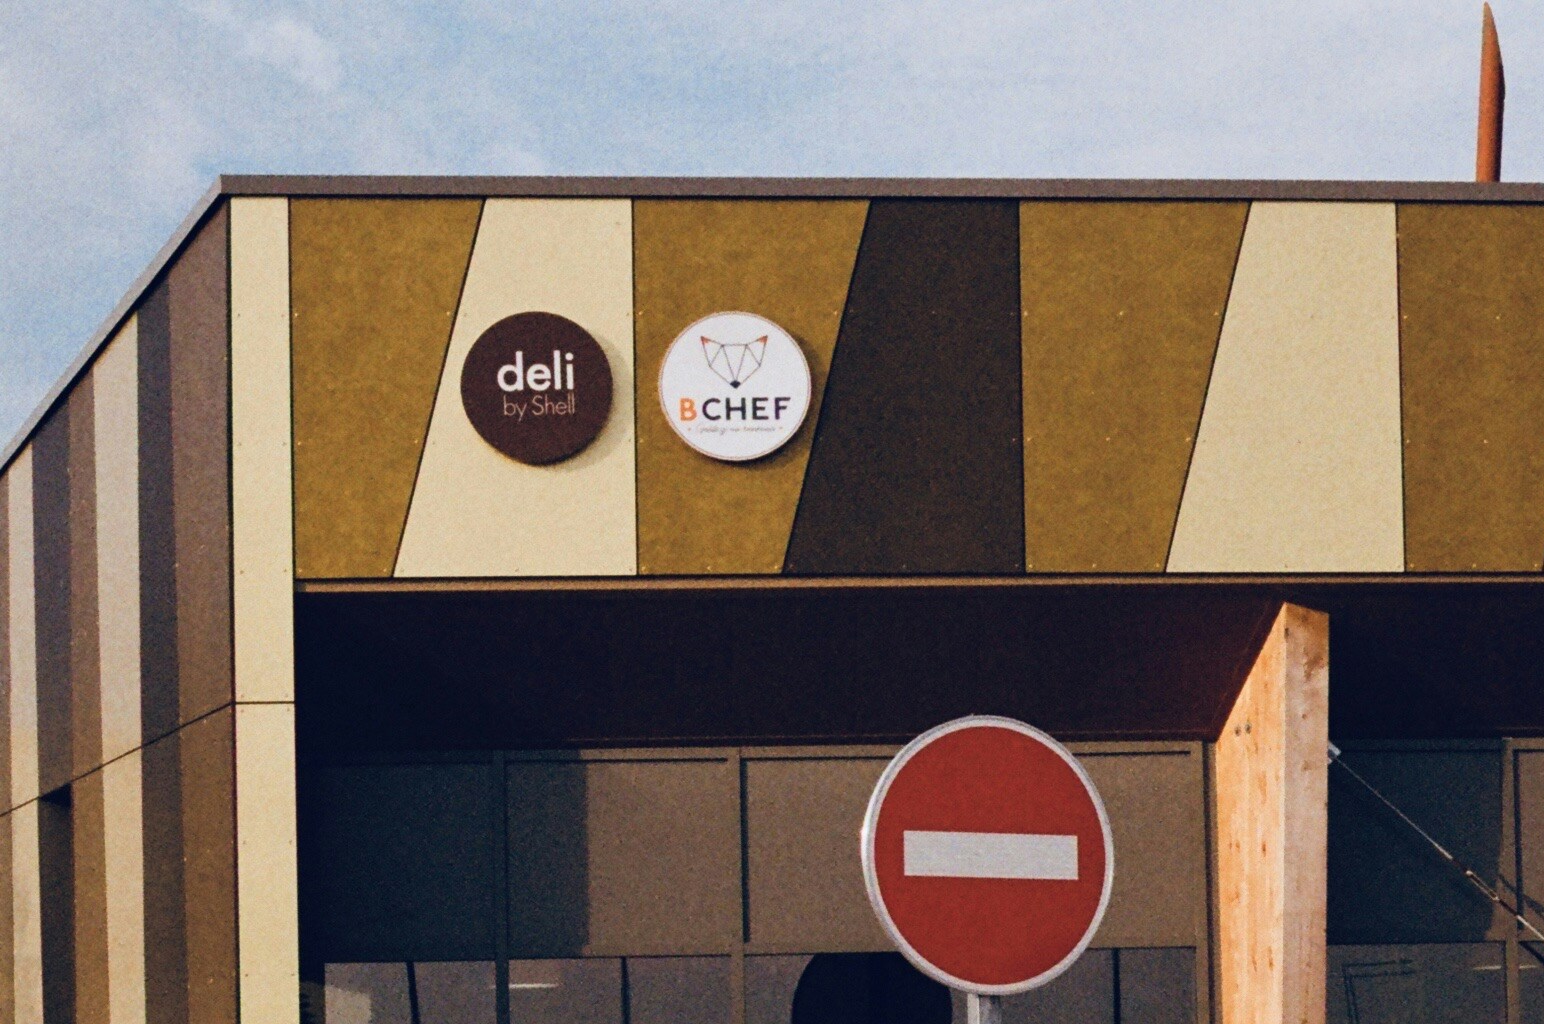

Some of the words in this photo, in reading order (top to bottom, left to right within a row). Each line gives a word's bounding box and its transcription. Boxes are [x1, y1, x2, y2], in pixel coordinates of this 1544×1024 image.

[497, 350, 574, 392] deli
[503, 394, 528, 422] by
[532, 393, 576, 416] Shell
